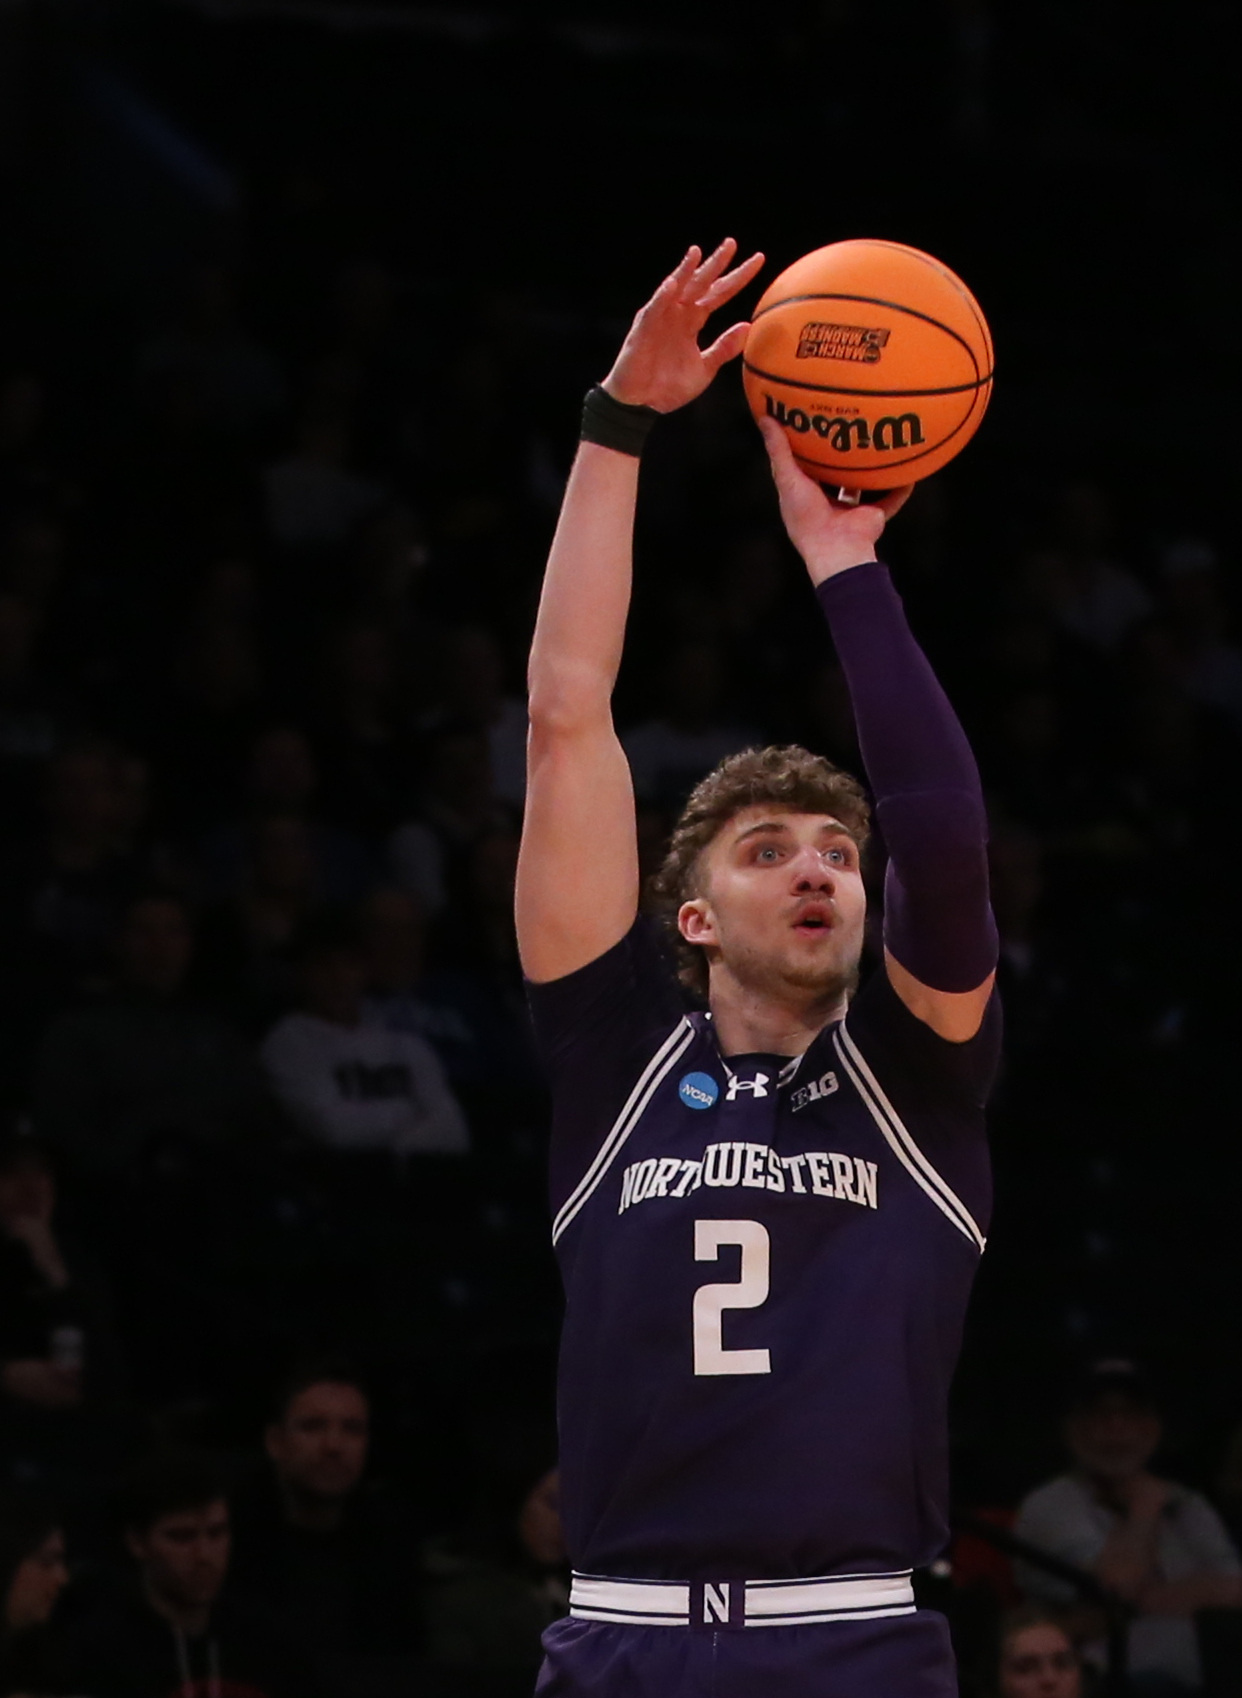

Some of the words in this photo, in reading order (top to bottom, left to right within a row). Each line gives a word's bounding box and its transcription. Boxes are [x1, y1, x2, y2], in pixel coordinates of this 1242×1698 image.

[764, 392, 925, 452] Wilson
[681, 1084, 714, 1107] NCAA
[618, 1141, 879, 1215] NORTWESTERN
[693, 1219, 772, 1376] 2
[703, 1582, 731, 1623] N
